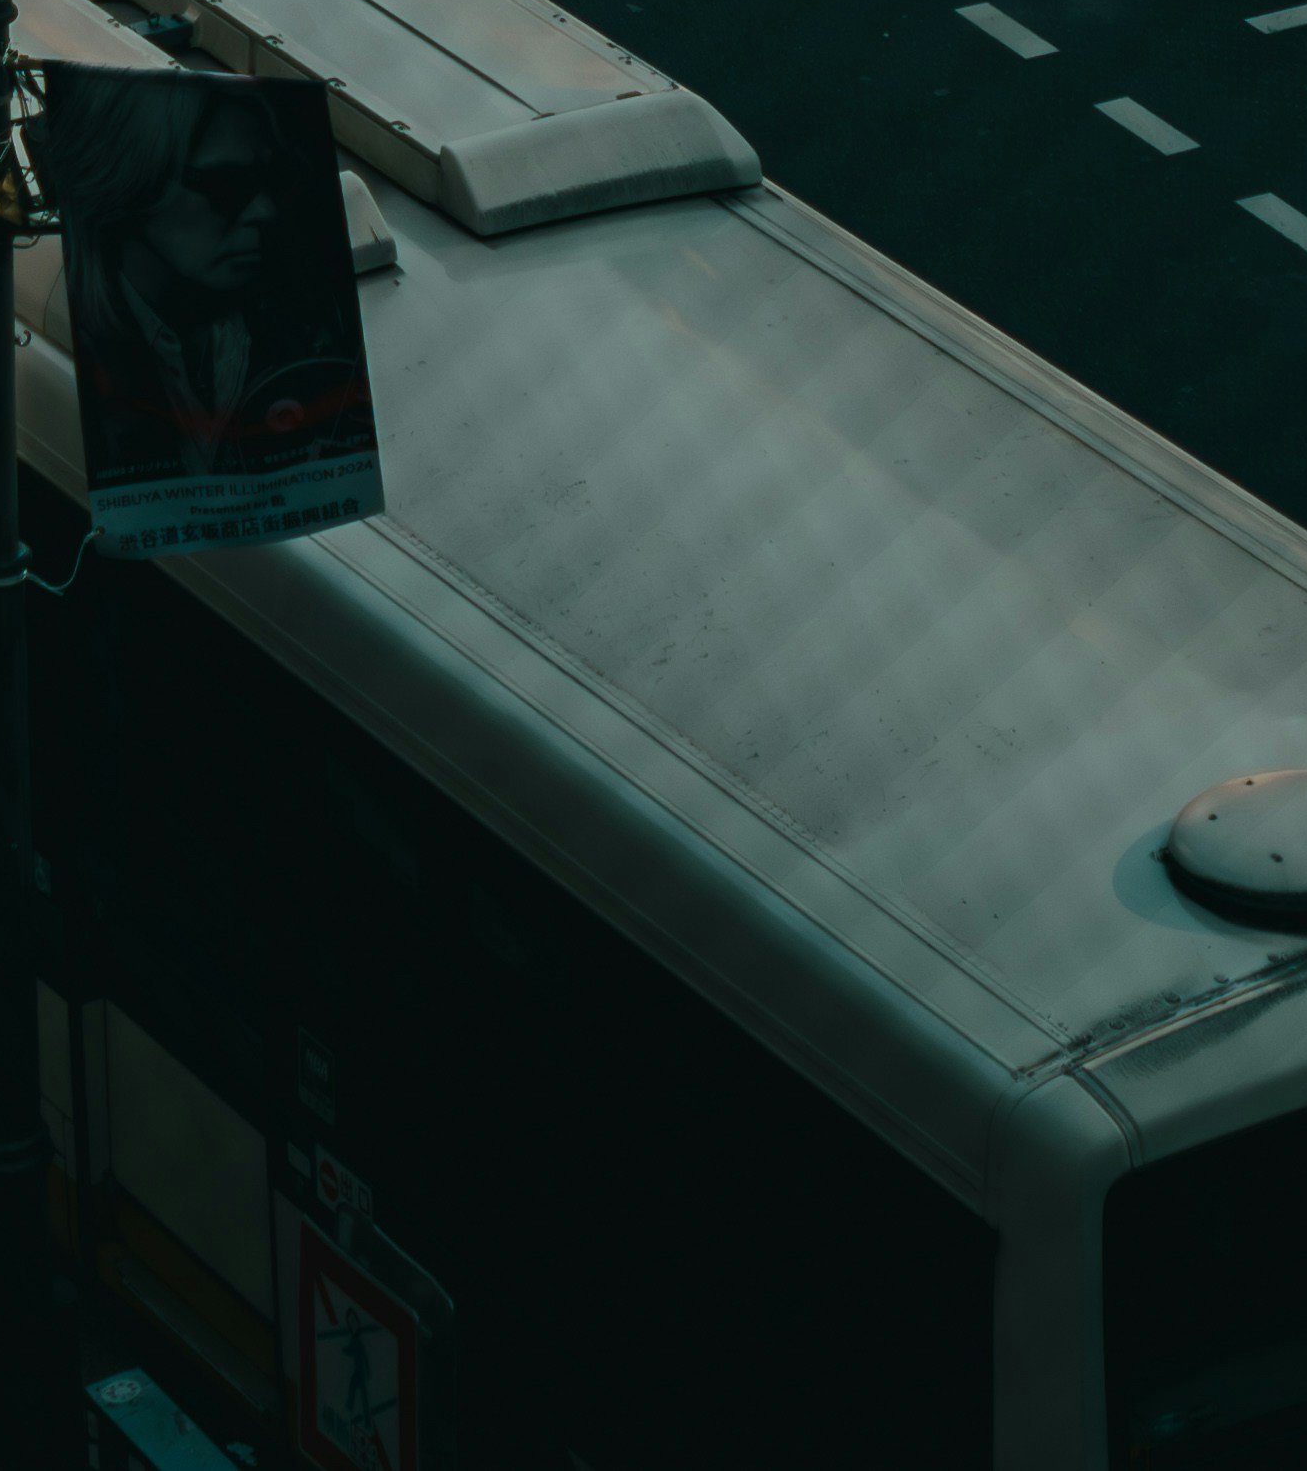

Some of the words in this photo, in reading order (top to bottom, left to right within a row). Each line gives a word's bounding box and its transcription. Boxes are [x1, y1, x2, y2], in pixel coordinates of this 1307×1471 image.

[96, 489, 162, 512] SHIBUYA
[164, 484, 225, 502] WINTER
[228, 468, 334, 496] ILLUMINATION
[335, 460, 374, 476] 2024
